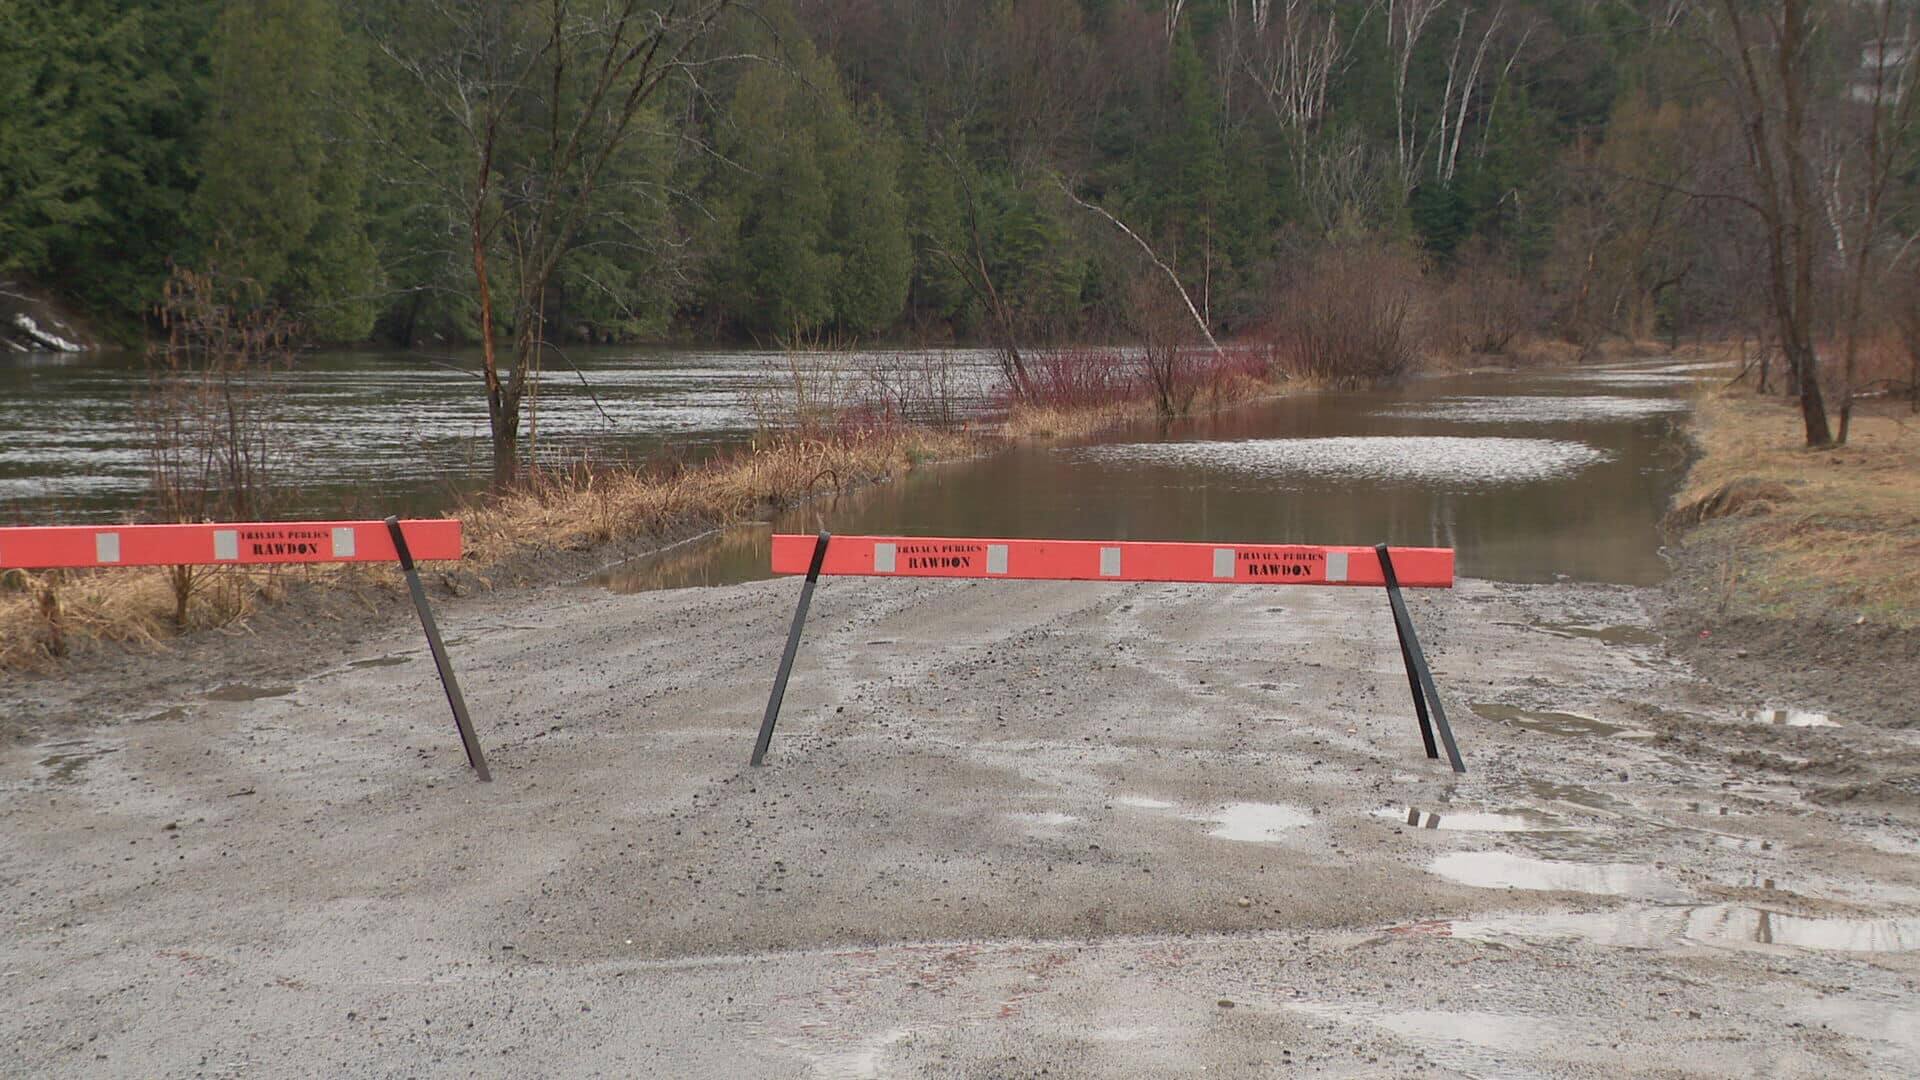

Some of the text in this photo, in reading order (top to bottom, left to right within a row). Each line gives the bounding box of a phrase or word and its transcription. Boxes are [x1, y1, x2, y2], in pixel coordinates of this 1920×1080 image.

[253, 543, 318, 555] RAWDON
[908, 557, 971, 569] RAWDON
[1248, 564, 1312, 576] RAWDON
